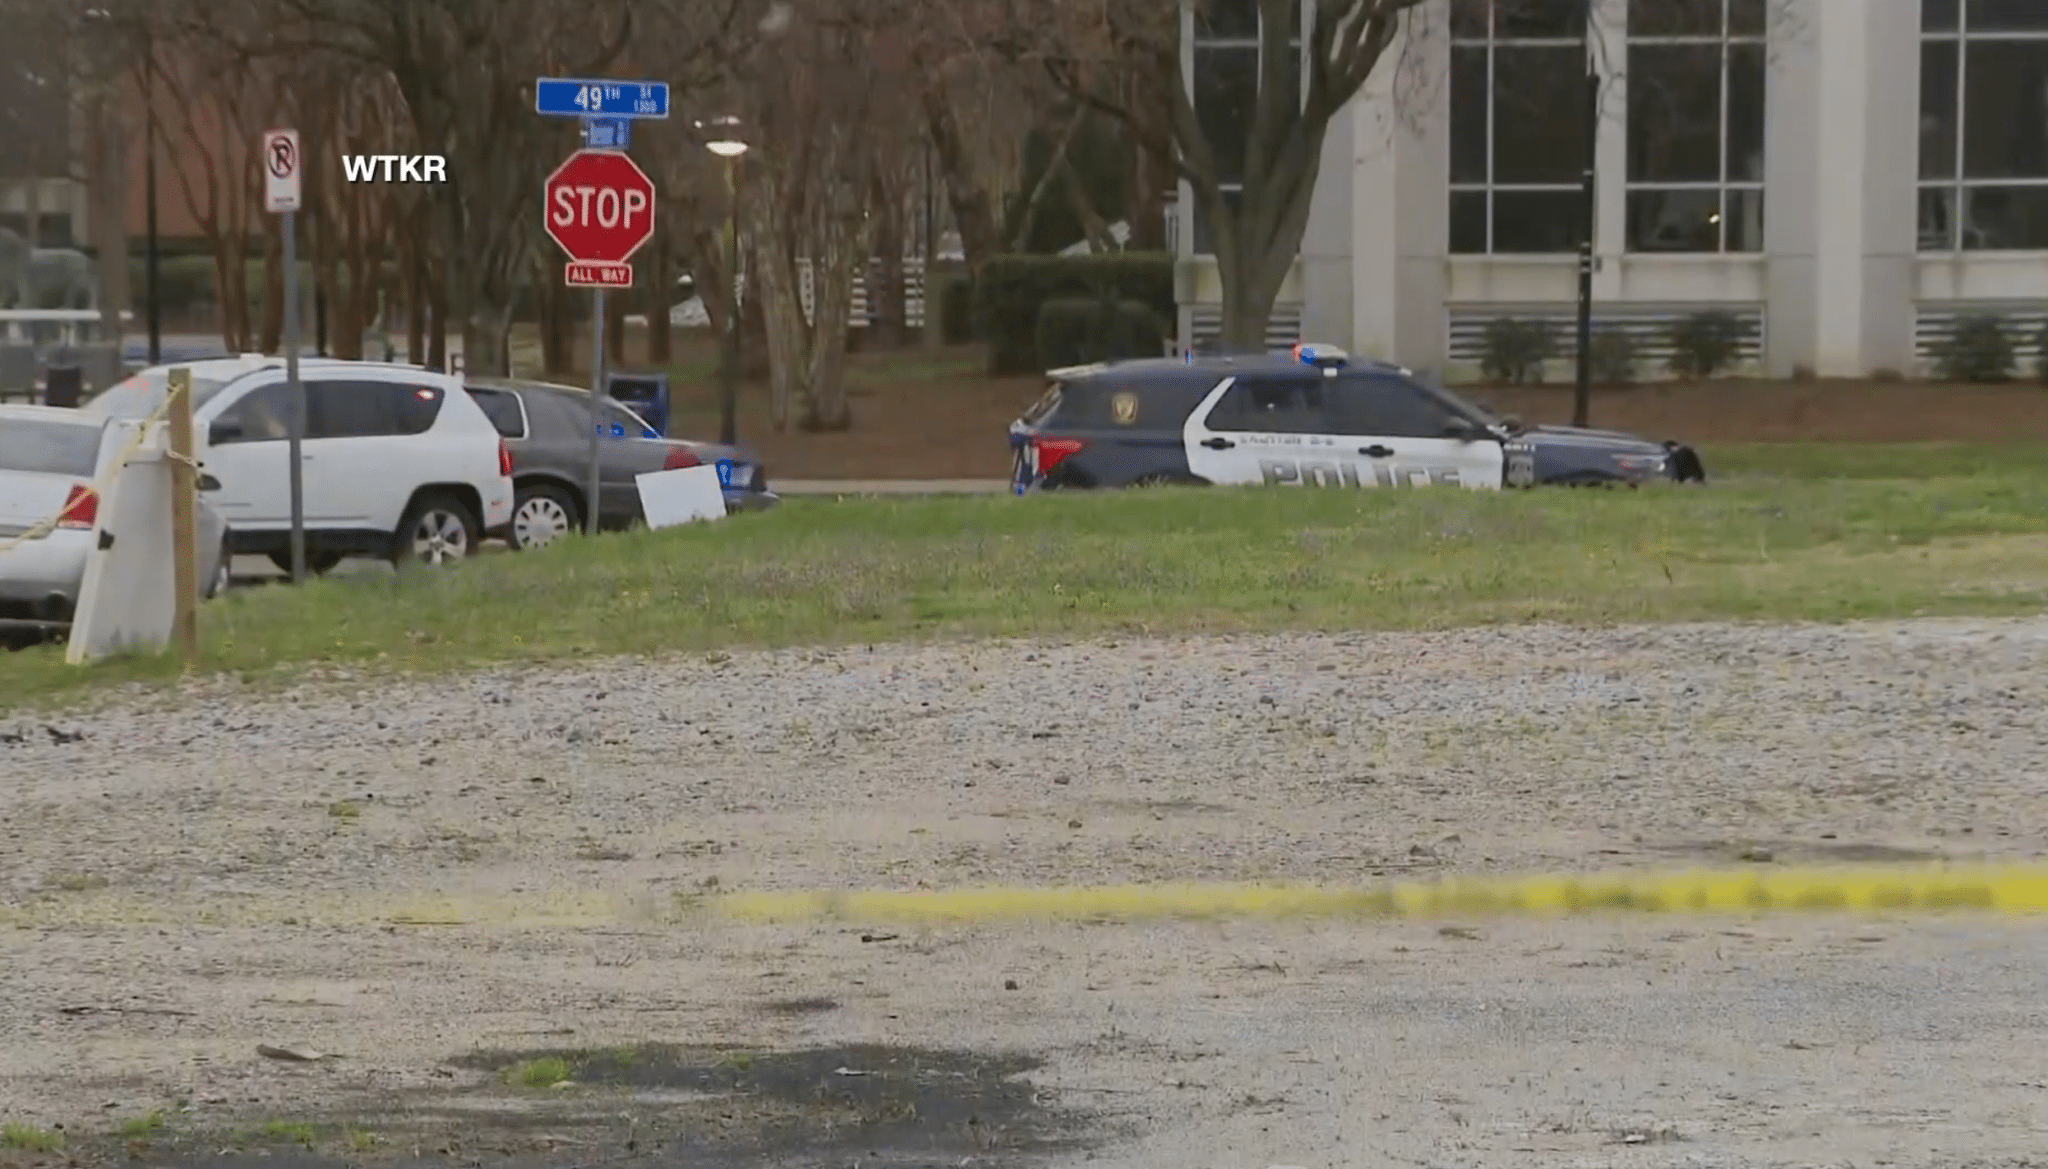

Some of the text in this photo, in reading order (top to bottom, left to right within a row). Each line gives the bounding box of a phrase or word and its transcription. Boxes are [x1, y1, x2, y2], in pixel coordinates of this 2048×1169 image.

[552, 185, 647, 229] STOP
[571, 267, 626, 283] ALL WAY
